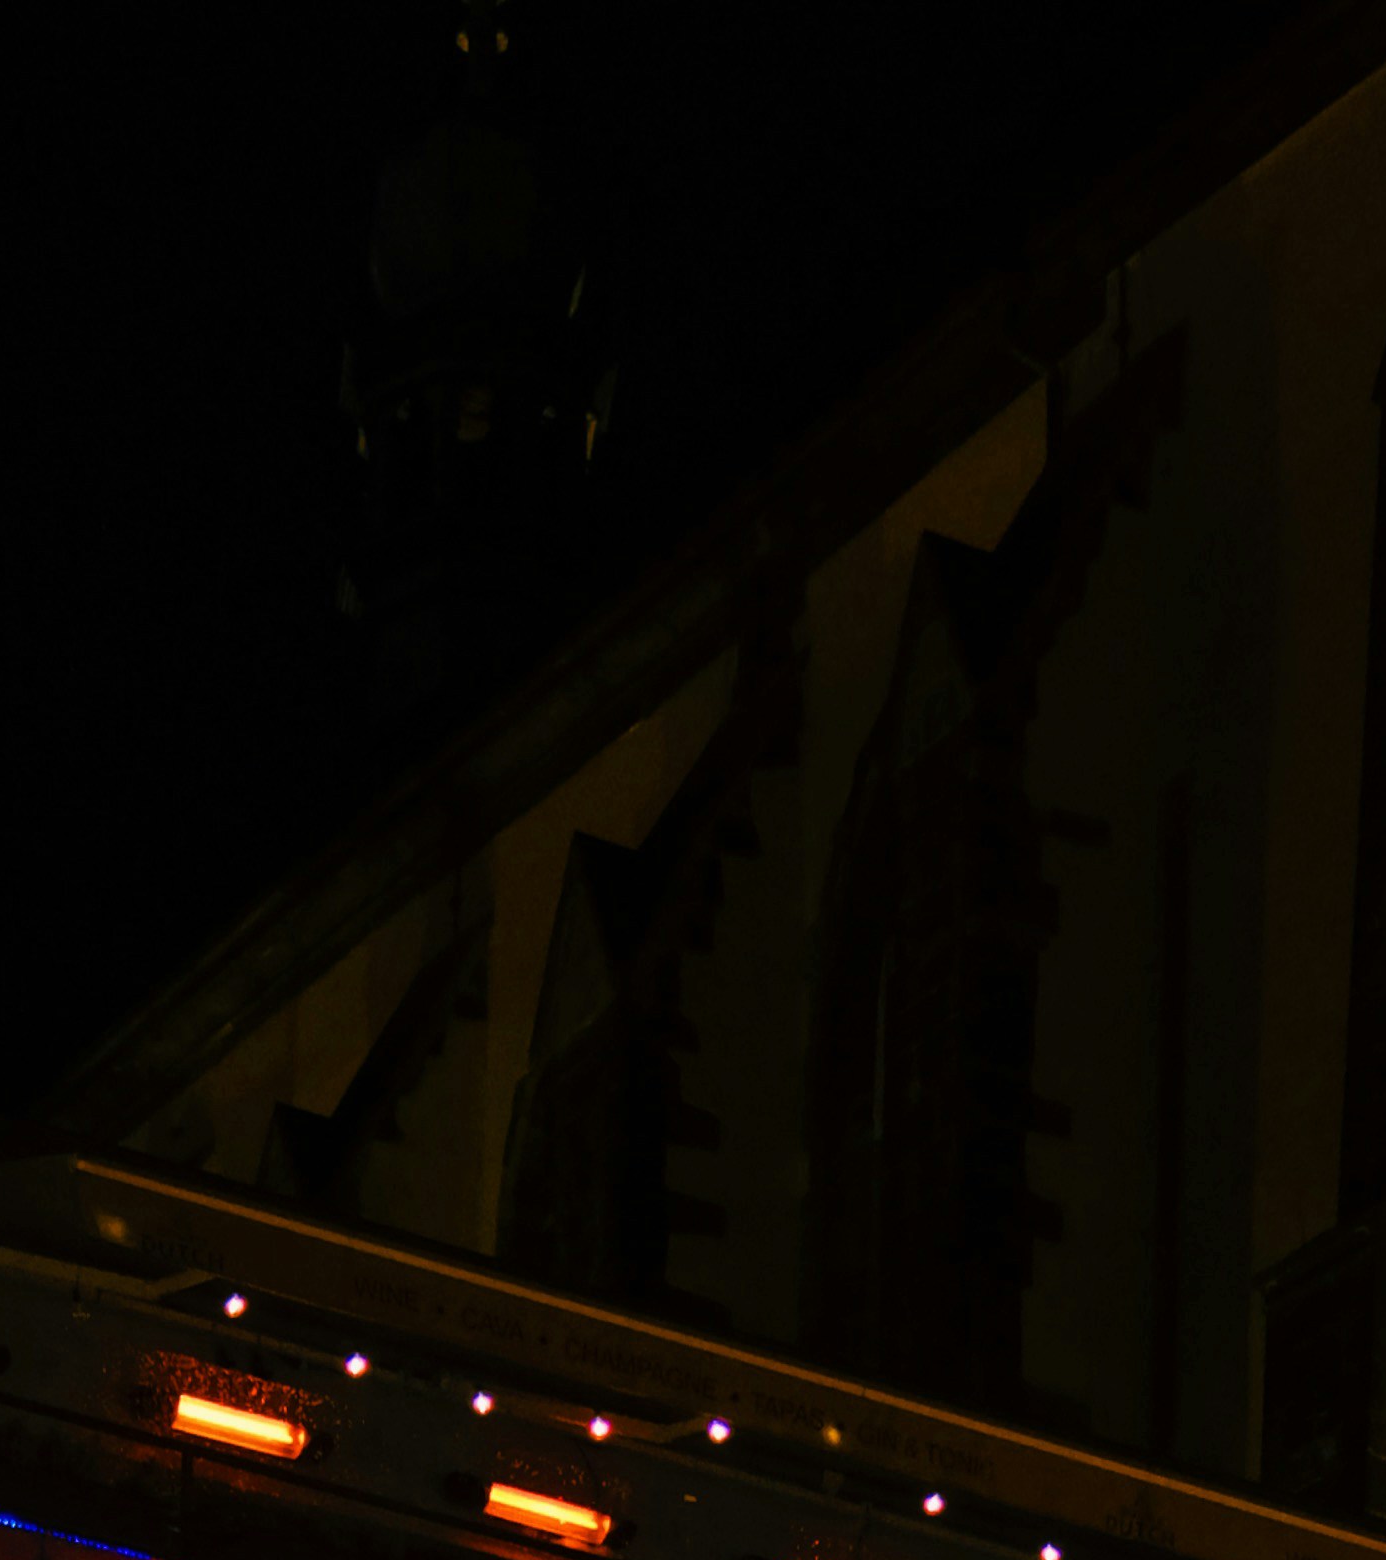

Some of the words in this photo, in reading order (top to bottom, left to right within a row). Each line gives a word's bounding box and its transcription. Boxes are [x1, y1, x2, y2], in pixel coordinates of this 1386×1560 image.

[353, 1275, 419, 1312] WINE
[460, 1304, 524, 1342] CAVA
[564, 1337, 718, 1402] CHAMPAGNE
[751, 1390, 826, 1430] TAPAS
[856, 1422, 899, 1451] GIN
